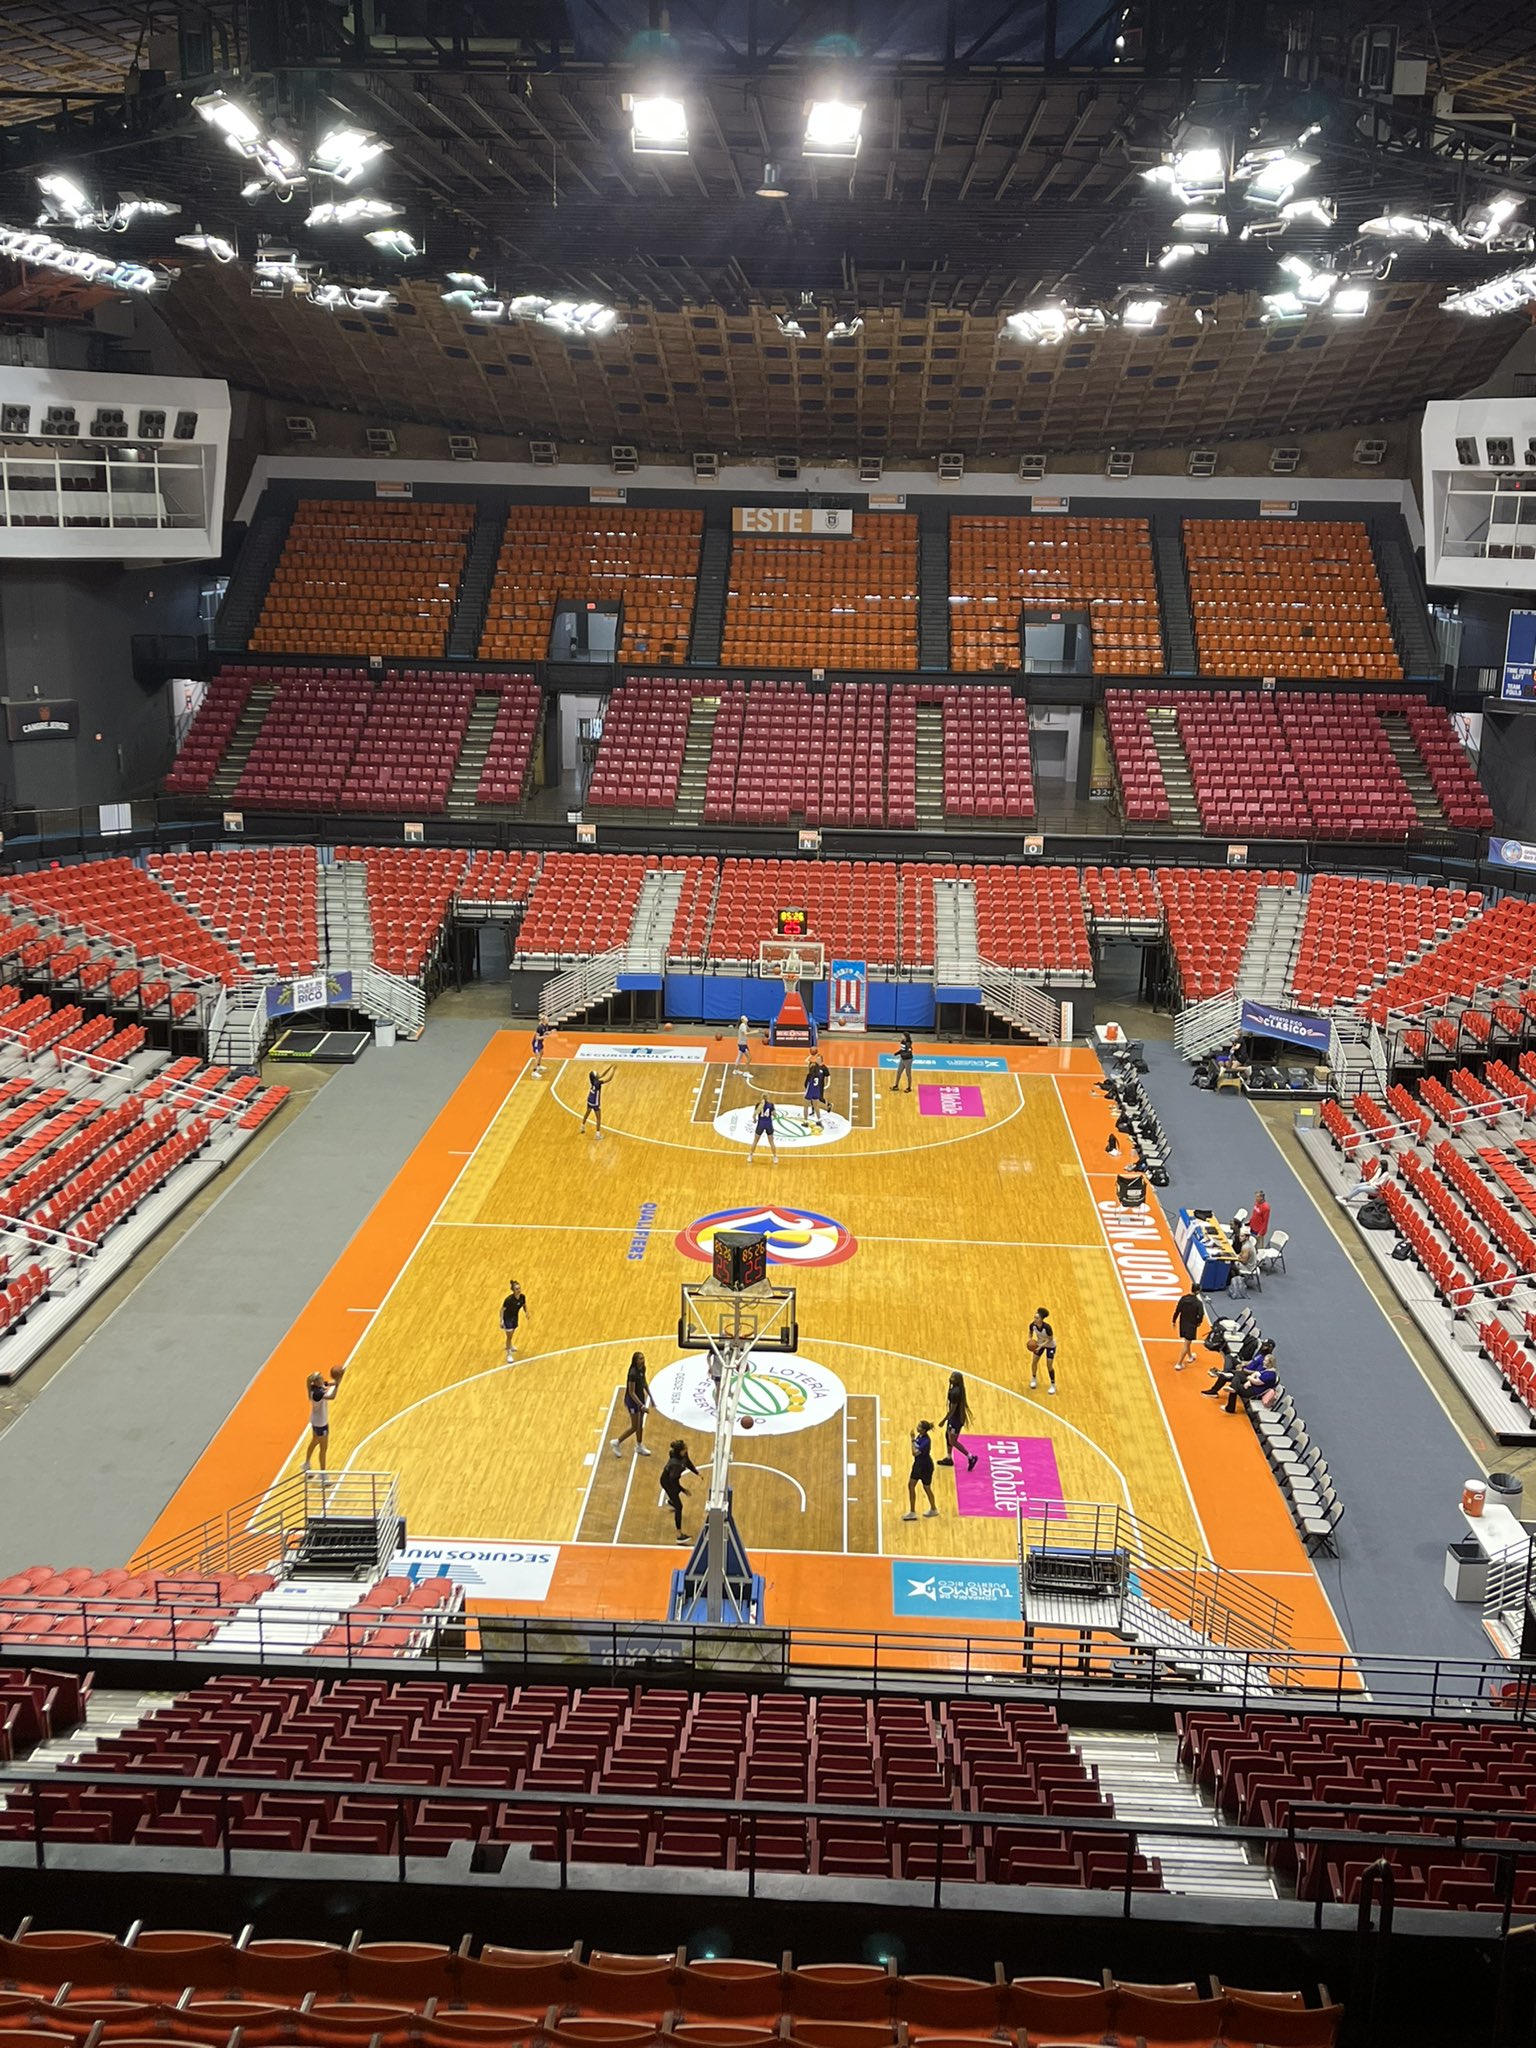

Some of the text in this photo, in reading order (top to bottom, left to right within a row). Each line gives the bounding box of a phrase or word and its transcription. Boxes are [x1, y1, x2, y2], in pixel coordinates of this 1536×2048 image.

[742, 508, 804, 532] ESTE
[582, 833, 592, 842] M
[804, 839, 812, 848] N
[297, 981, 315, 991] PLAY
[297, 986, 323, 995] PUERTO
[298, 991, 323, 1004] RICO
[1268, 1014, 1303, 1028] PUERTO RICO
[813, 1077, 820, 1087] 3
[627, 1202, 658, 1261] QUALIFIERS
[1112, 1242, 1184, 1301] JUAN
[447, 1550, 552, 1563] SEGUROS
[938, 1585, 1014, 1600] TURISMO
